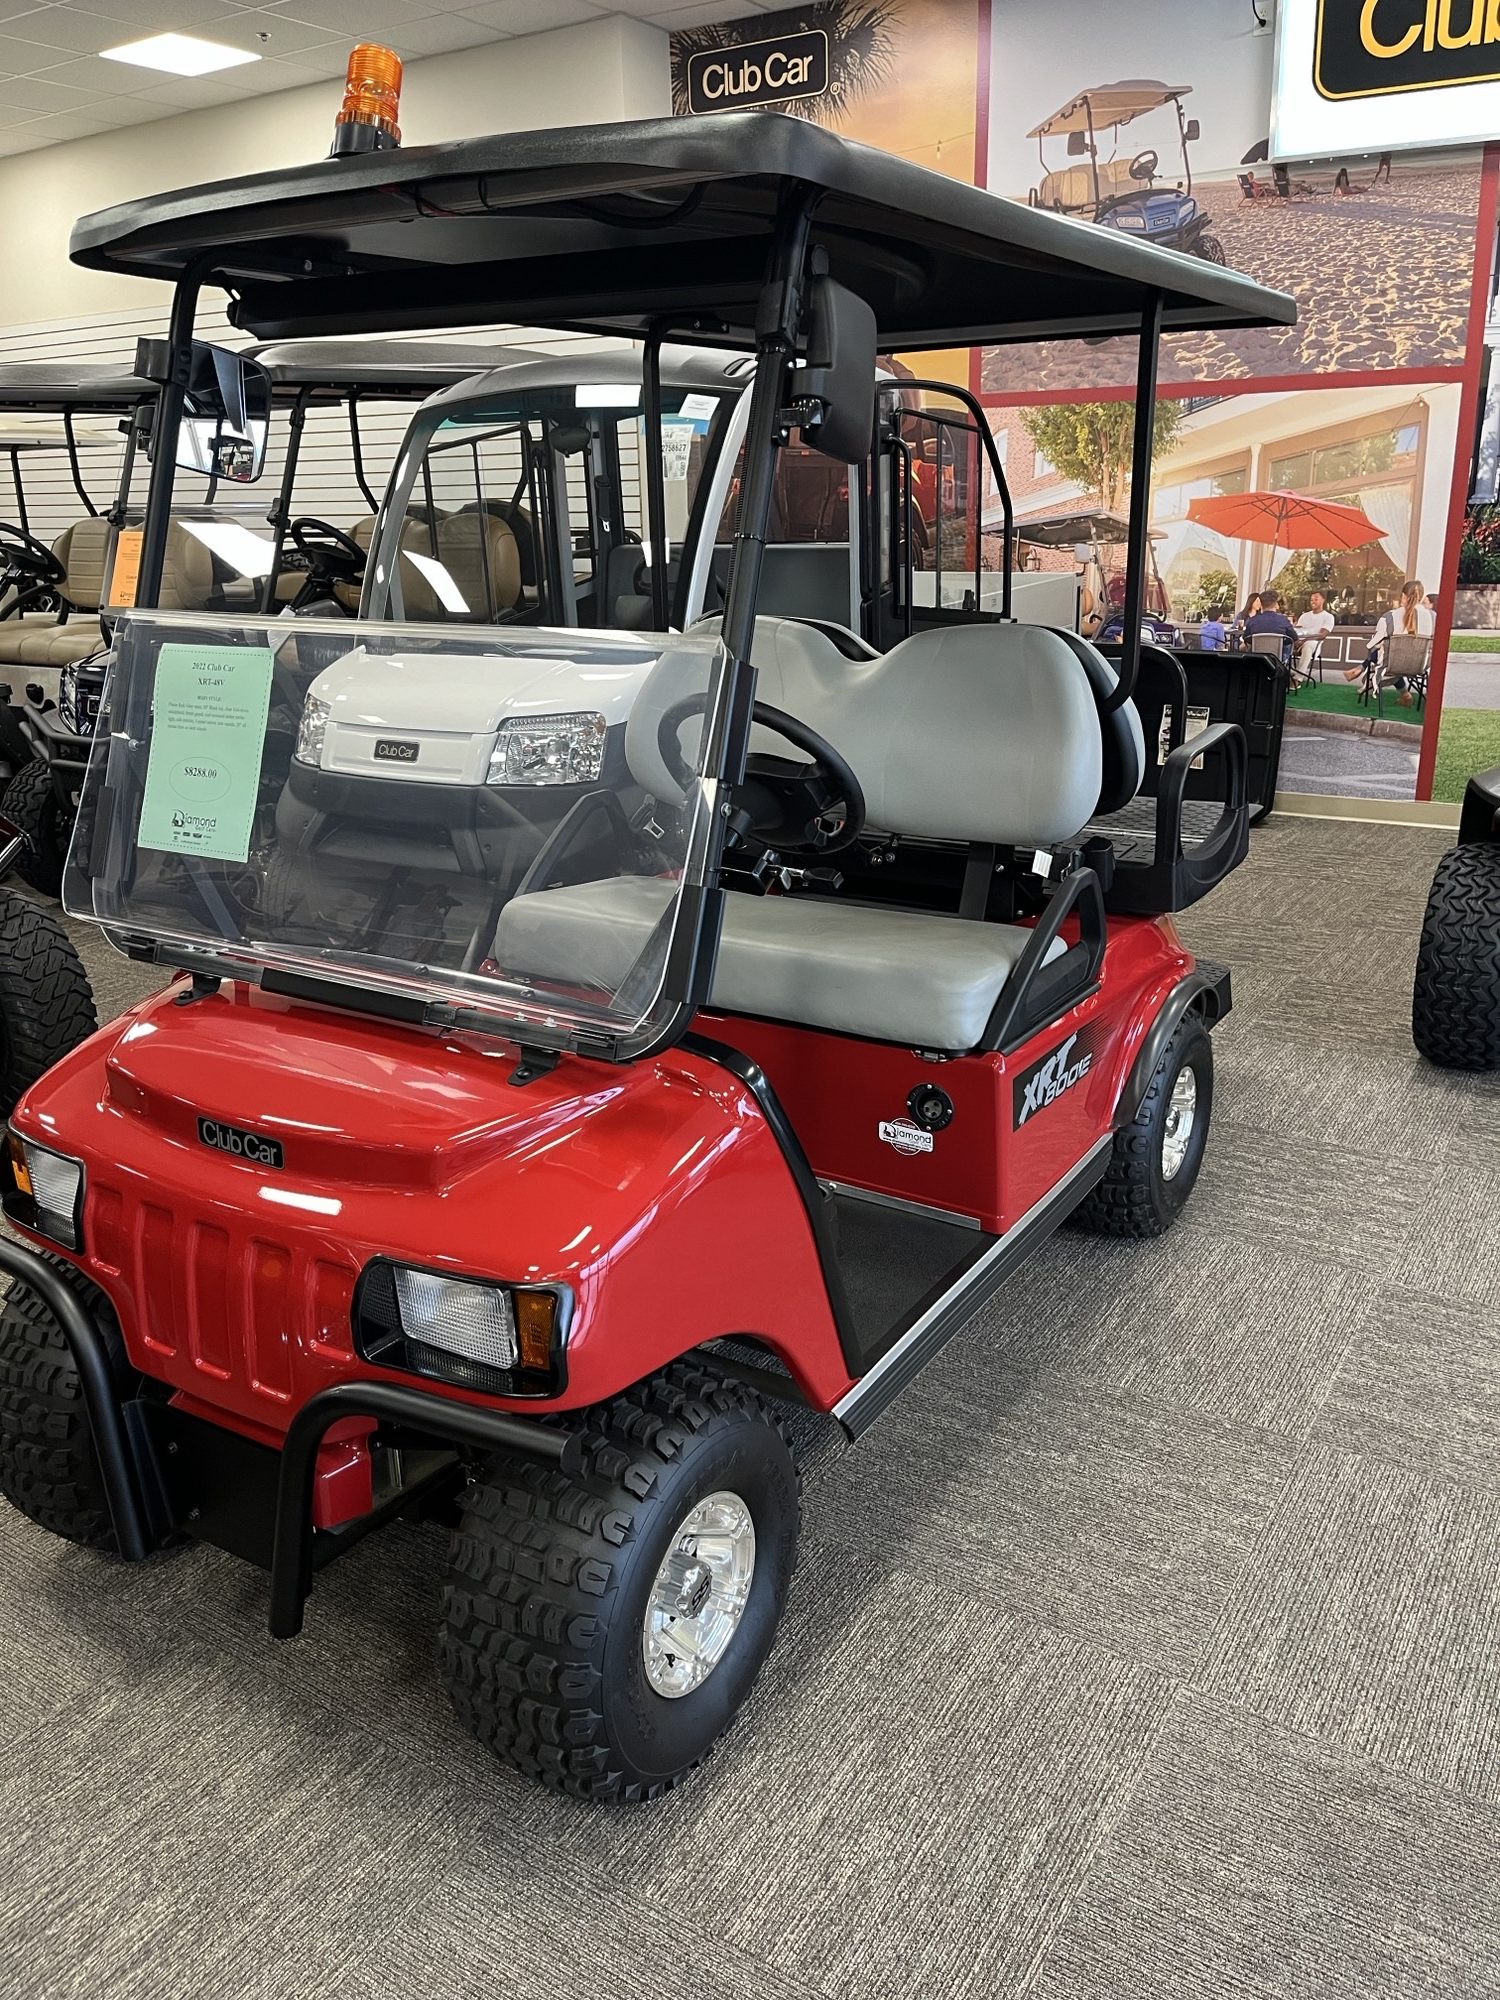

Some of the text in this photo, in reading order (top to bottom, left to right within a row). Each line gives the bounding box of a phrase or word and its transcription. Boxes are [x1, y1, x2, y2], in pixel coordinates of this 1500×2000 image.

[702, 52, 814, 99] Club Car
[192, 662, 236, 673] 2022 Club Car
[198, 678, 226, 687] XRT-48V
[379, 744, 415, 758] Club Car
[184, 766, 217, 779] $8288.00
[172, 809, 217, 828] Diamond
[1019, 1031, 1078, 1126] XRT
[1044, 1052, 1093, 1106] 800E
[203, 1121, 277, 1165] Club Car
[883, 1124, 931, 1144] Diamond
